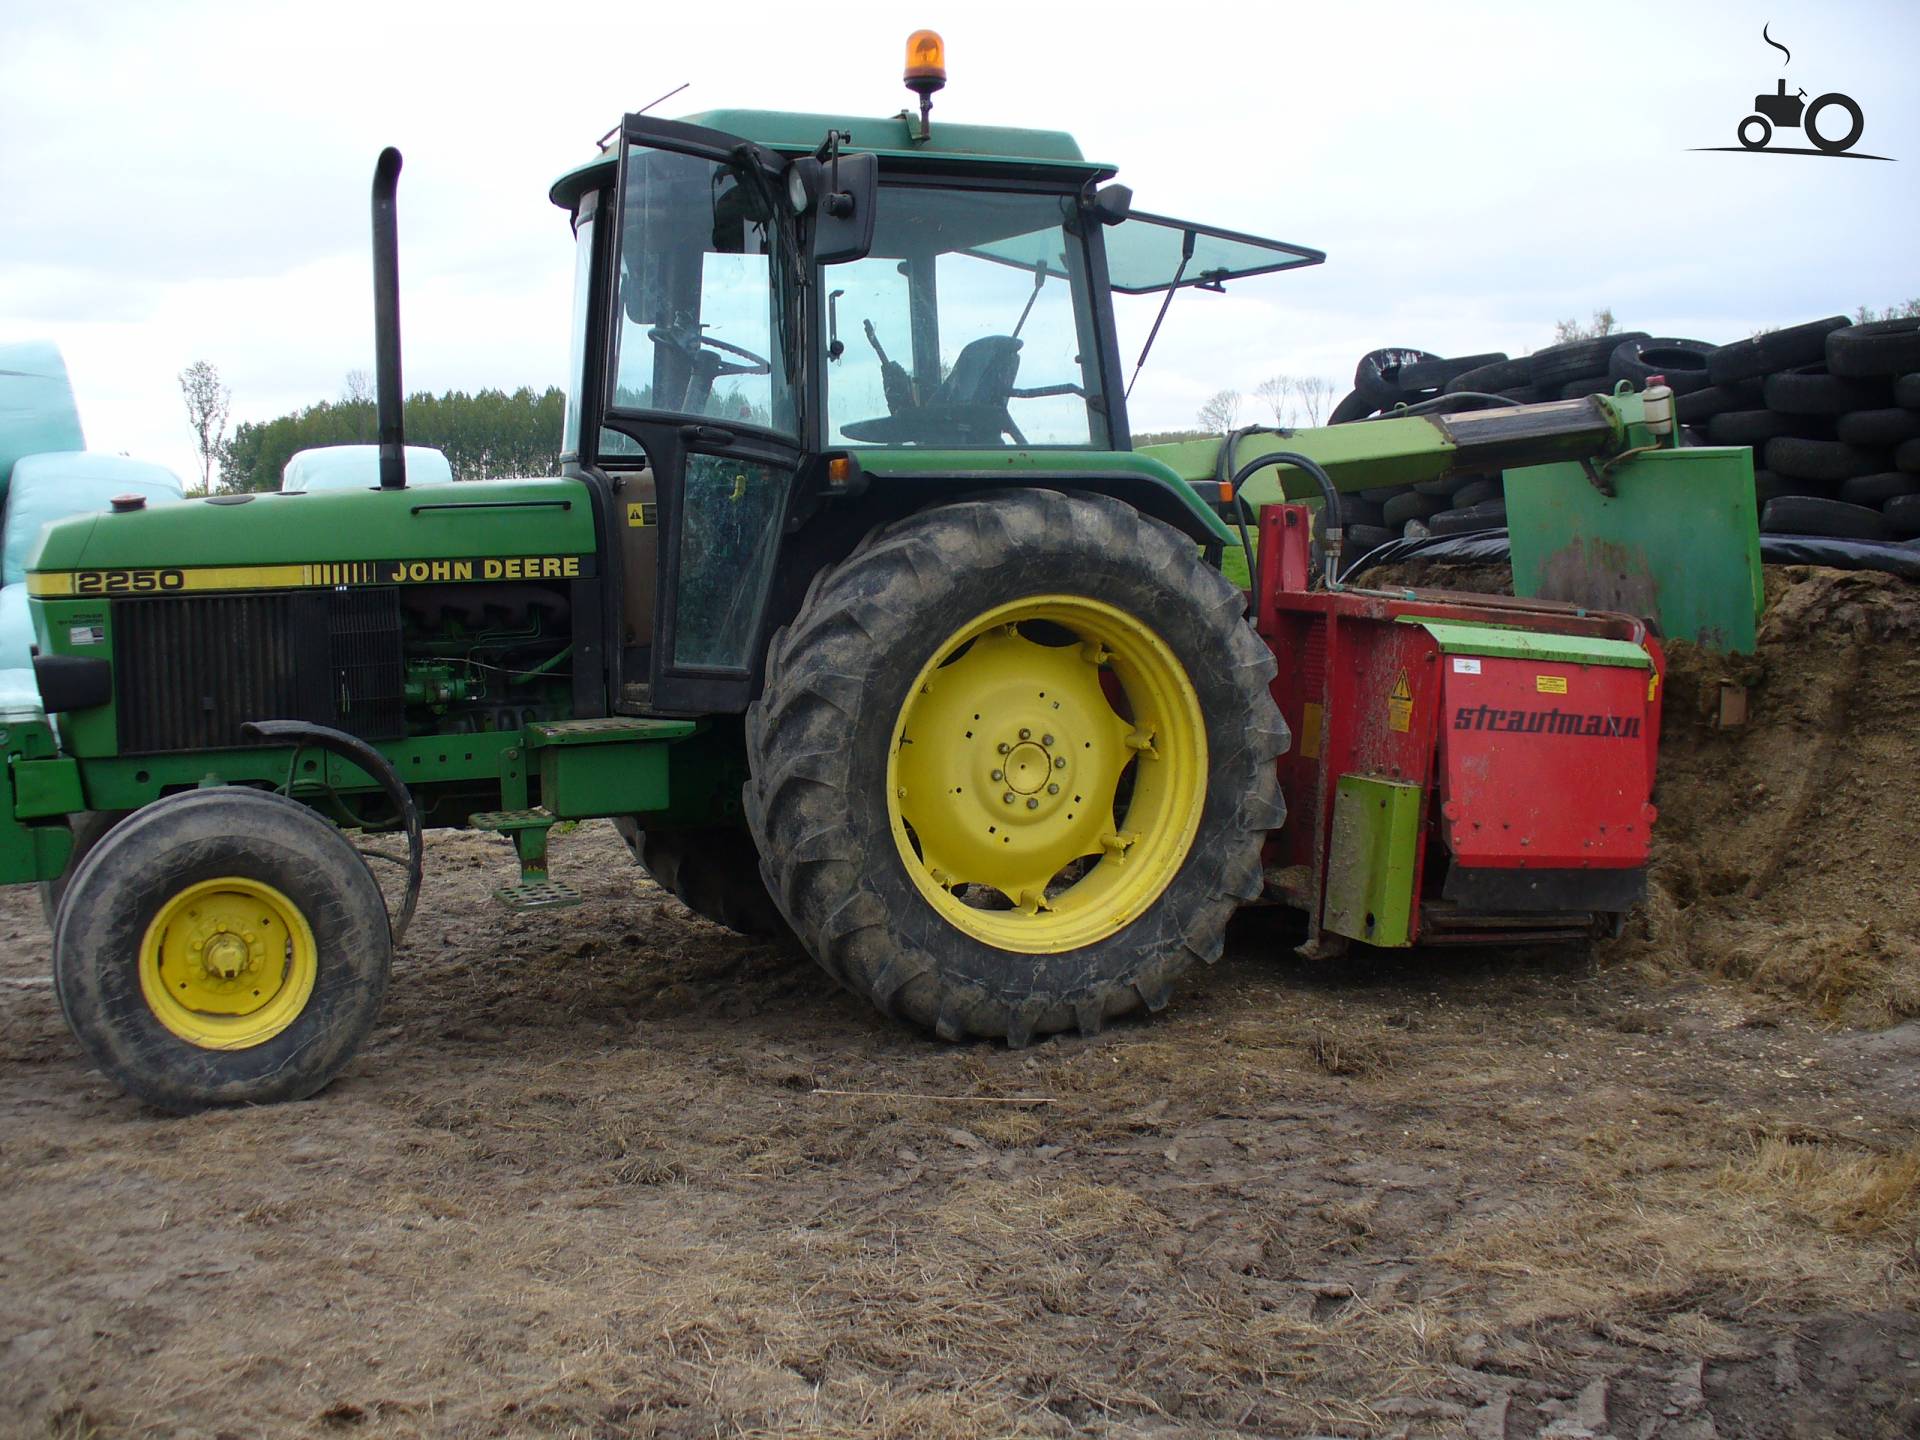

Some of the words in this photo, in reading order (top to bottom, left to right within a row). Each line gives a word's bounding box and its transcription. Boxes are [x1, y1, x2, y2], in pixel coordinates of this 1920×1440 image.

[79, 569, 184, 592] 2250
[392, 561, 473, 582] JOHN
[484, 557, 580, 579] DEERE
[1454, 704, 1641, 738] strautmann
